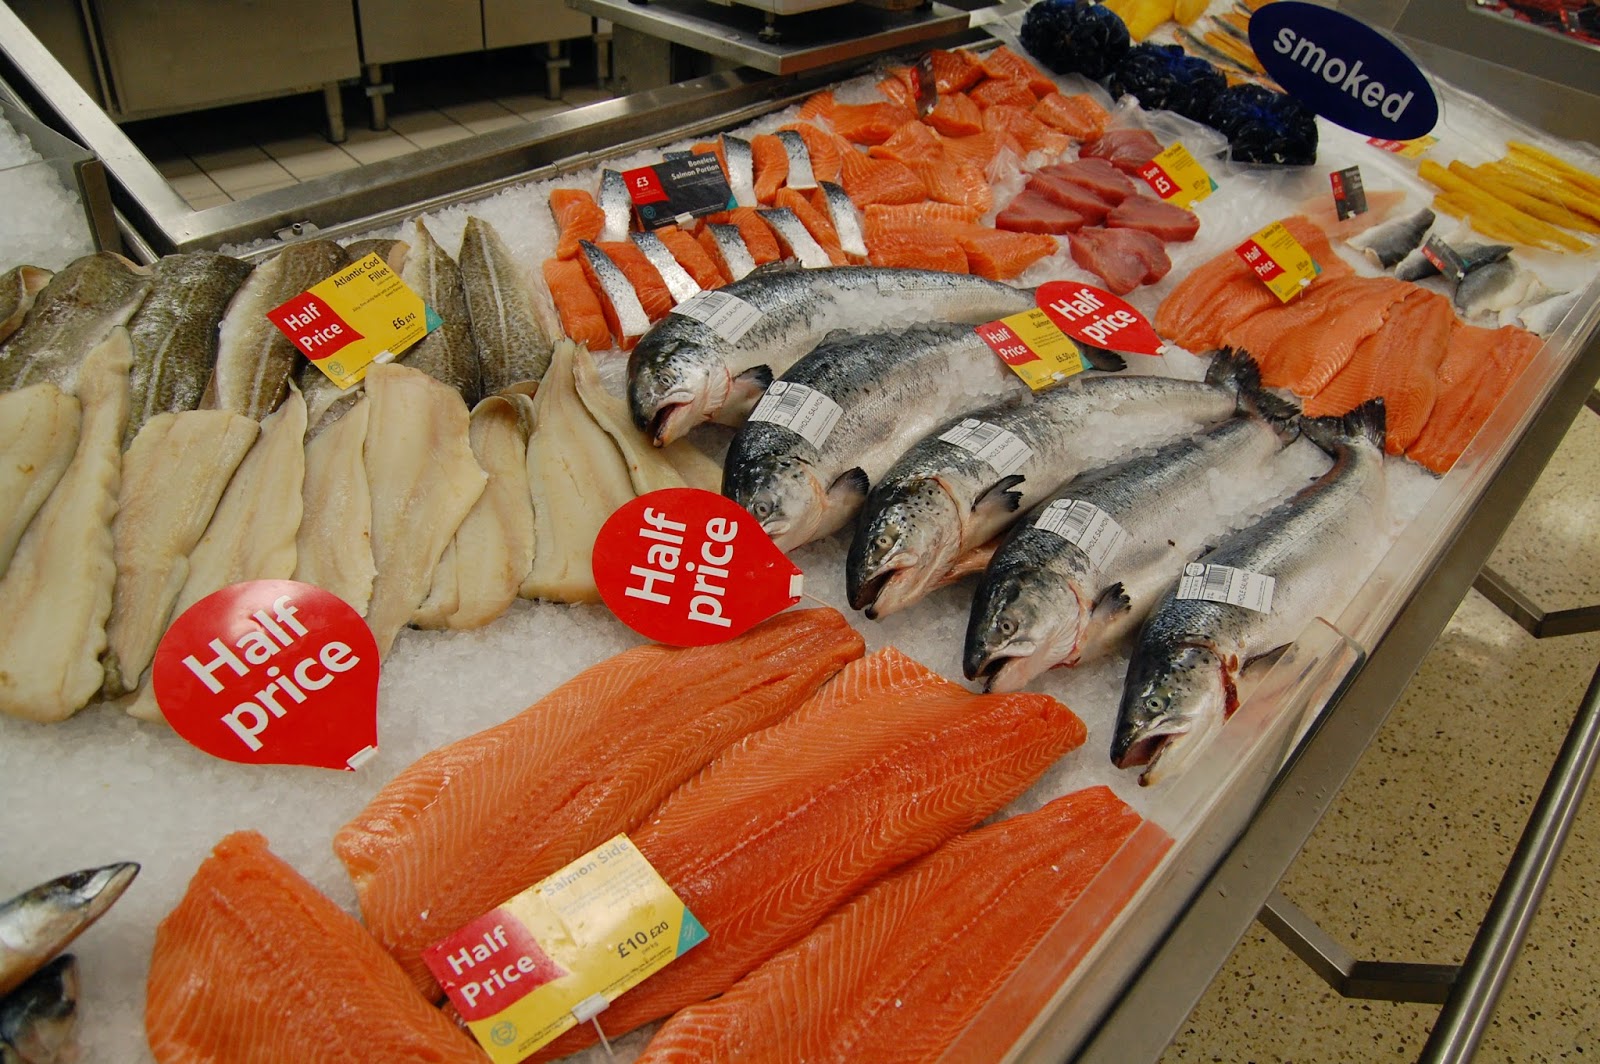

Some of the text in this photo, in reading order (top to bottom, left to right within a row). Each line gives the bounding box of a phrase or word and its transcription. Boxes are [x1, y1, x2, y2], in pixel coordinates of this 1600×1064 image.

[1273, 27, 1415, 123] smoked
[670, 164, 720, 181] Salmon Portion
[687, 156, 717, 168] Boneless
[1143, 166, 1160, 180] Save
[636, 176, 650, 189] £3
[1243, 245, 1262, 263] Half
[1254, 260, 1276, 277] Price
[333, 266, 366, 289] Atlantic
[362, 256, 381, 271] Cod
[368, 267, 390, 283] Fillet
[283, 302, 322, 332] Half
[392, 312, 417, 331] £6 £12
[727, 302, 744, 319] SALMON
[1049, 288, 1105, 322] Half
[299, 322, 344, 352] Price
[986, 327, 1012, 345] Half
[1081, 309, 1138, 346] price
[999, 344, 1028, 361] Price
[797, 415, 812, 434] WHOLE
[808, 396, 825, 417] SALMON
[1085, 535, 1099, 555] WHOLE
[1094, 517, 1110, 538] SALMON
[624, 507, 687, 605] Half
[685, 517, 739, 628] price
[181, 594, 309, 695] Half
[220, 641, 361, 752] price
[543, 863, 598, 897] Salmon
[597, 840, 629, 867] Side
[446, 924, 511, 976] Half
[617, 921, 669, 959] £10 £20
[460, 953, 537, 1008] Price
